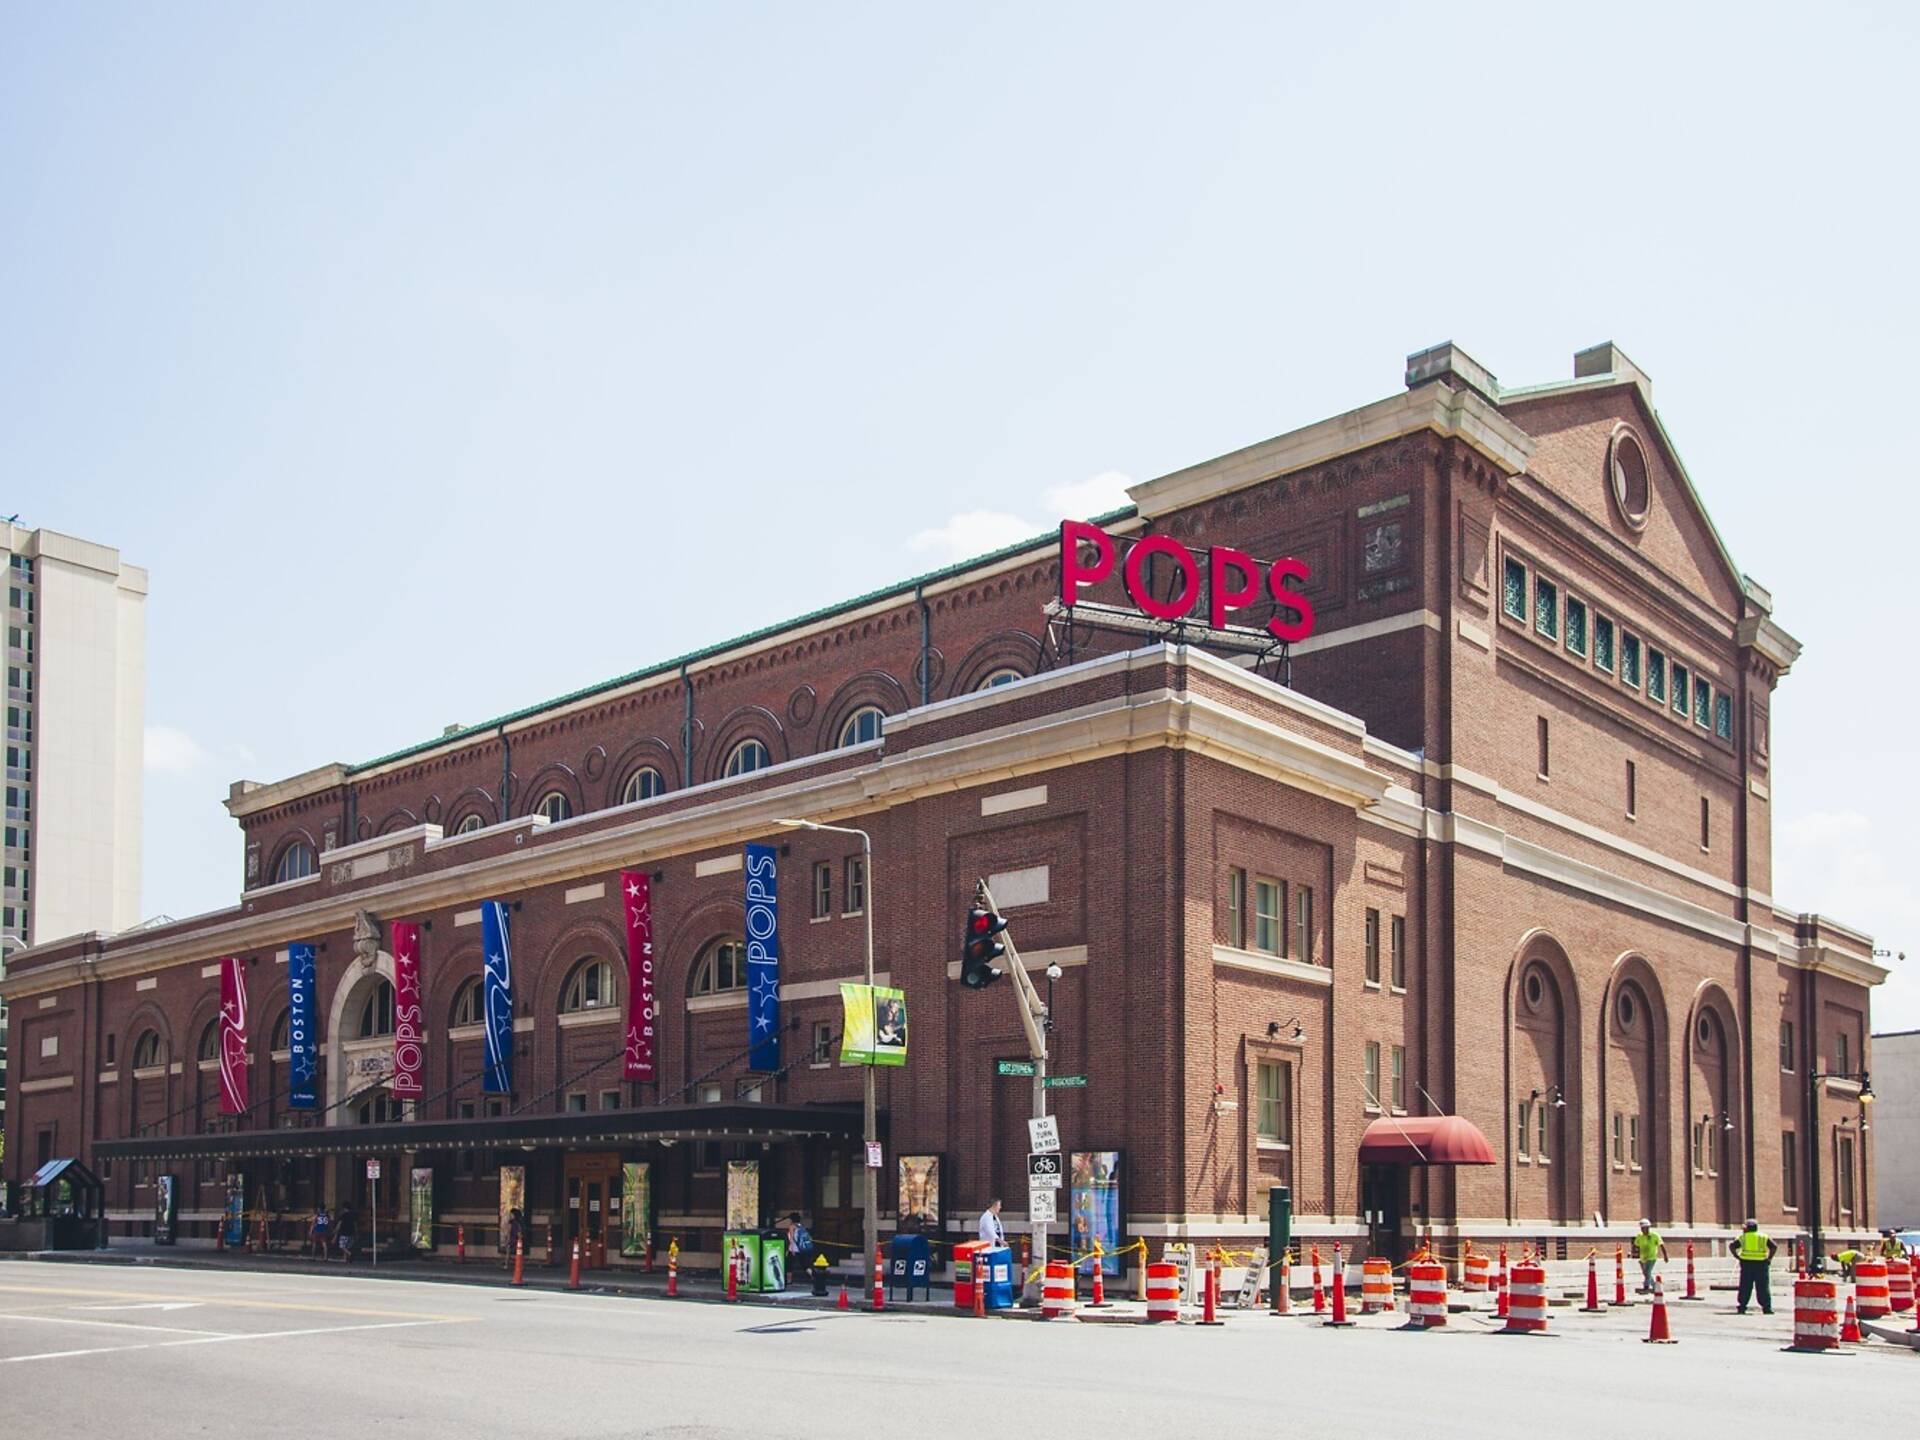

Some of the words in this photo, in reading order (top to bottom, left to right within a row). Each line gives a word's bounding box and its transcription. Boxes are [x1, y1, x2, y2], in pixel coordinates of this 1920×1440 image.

[1060, 519, 1316, 643] POPS
[747, 854, 777, 965] POPS
[292, 978, 304, 1053] BOSTON
[642, 942, 653, 1036] BOSTON
[395, 1005, 422, 1090] POPS
[1034, 1141, 1043, 1149] ON
[1044, 1138, 1057, 1147] RED
[1035, 1130, 1052, 1139] TURN
[1037, 1121, 1048, 1129] NO
